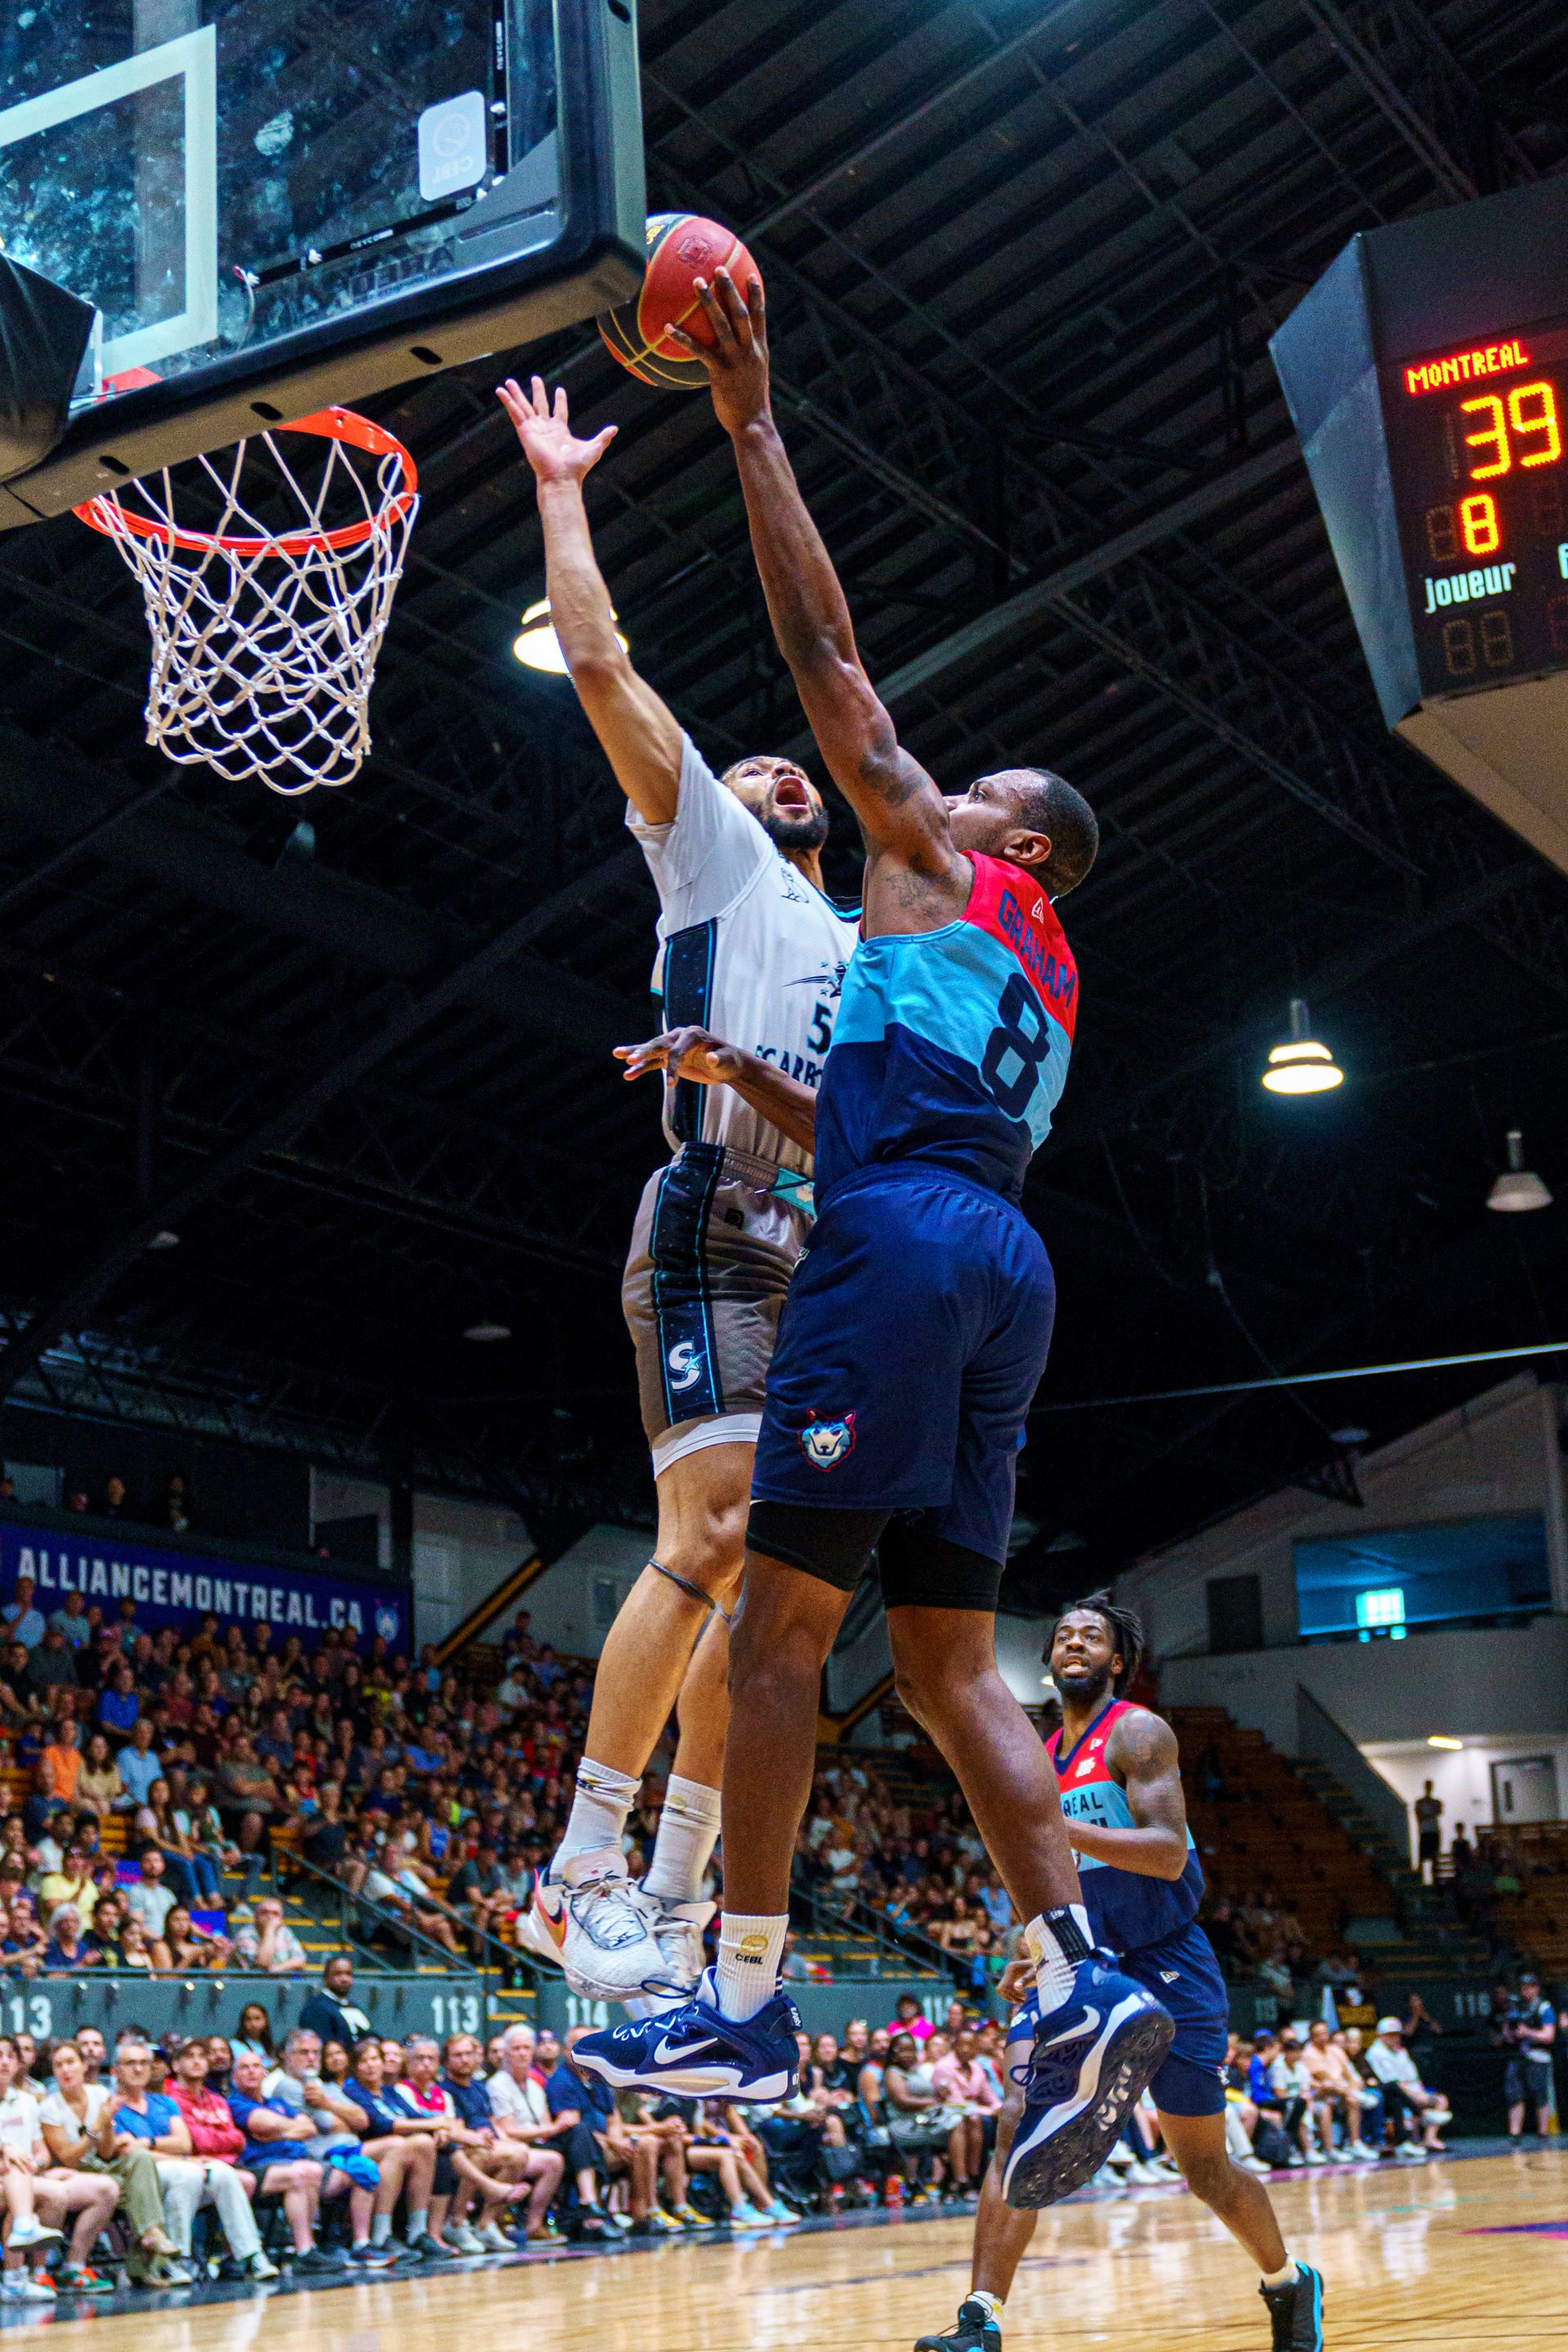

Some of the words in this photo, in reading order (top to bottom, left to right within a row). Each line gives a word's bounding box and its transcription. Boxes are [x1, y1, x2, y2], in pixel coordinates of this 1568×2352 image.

[1406, 340, 1530, 394] MONTREAL
[1460, 381, 1561, 481] 39
[1460, 493, 1499, 555] 8
[1423, 562, 1517, 614] joueur
[997, 889, 1077, 1010] GRAHAM
[981, 972, 1051, 1119] 8
[18, 1547, 364, 1633] ALLIANCEMONTREAL.CA
[735, 1953, 763, 1965] CEBL
[431, 1995, 480, 2034] 113
[790, 2007, 803, 2028] EASY
